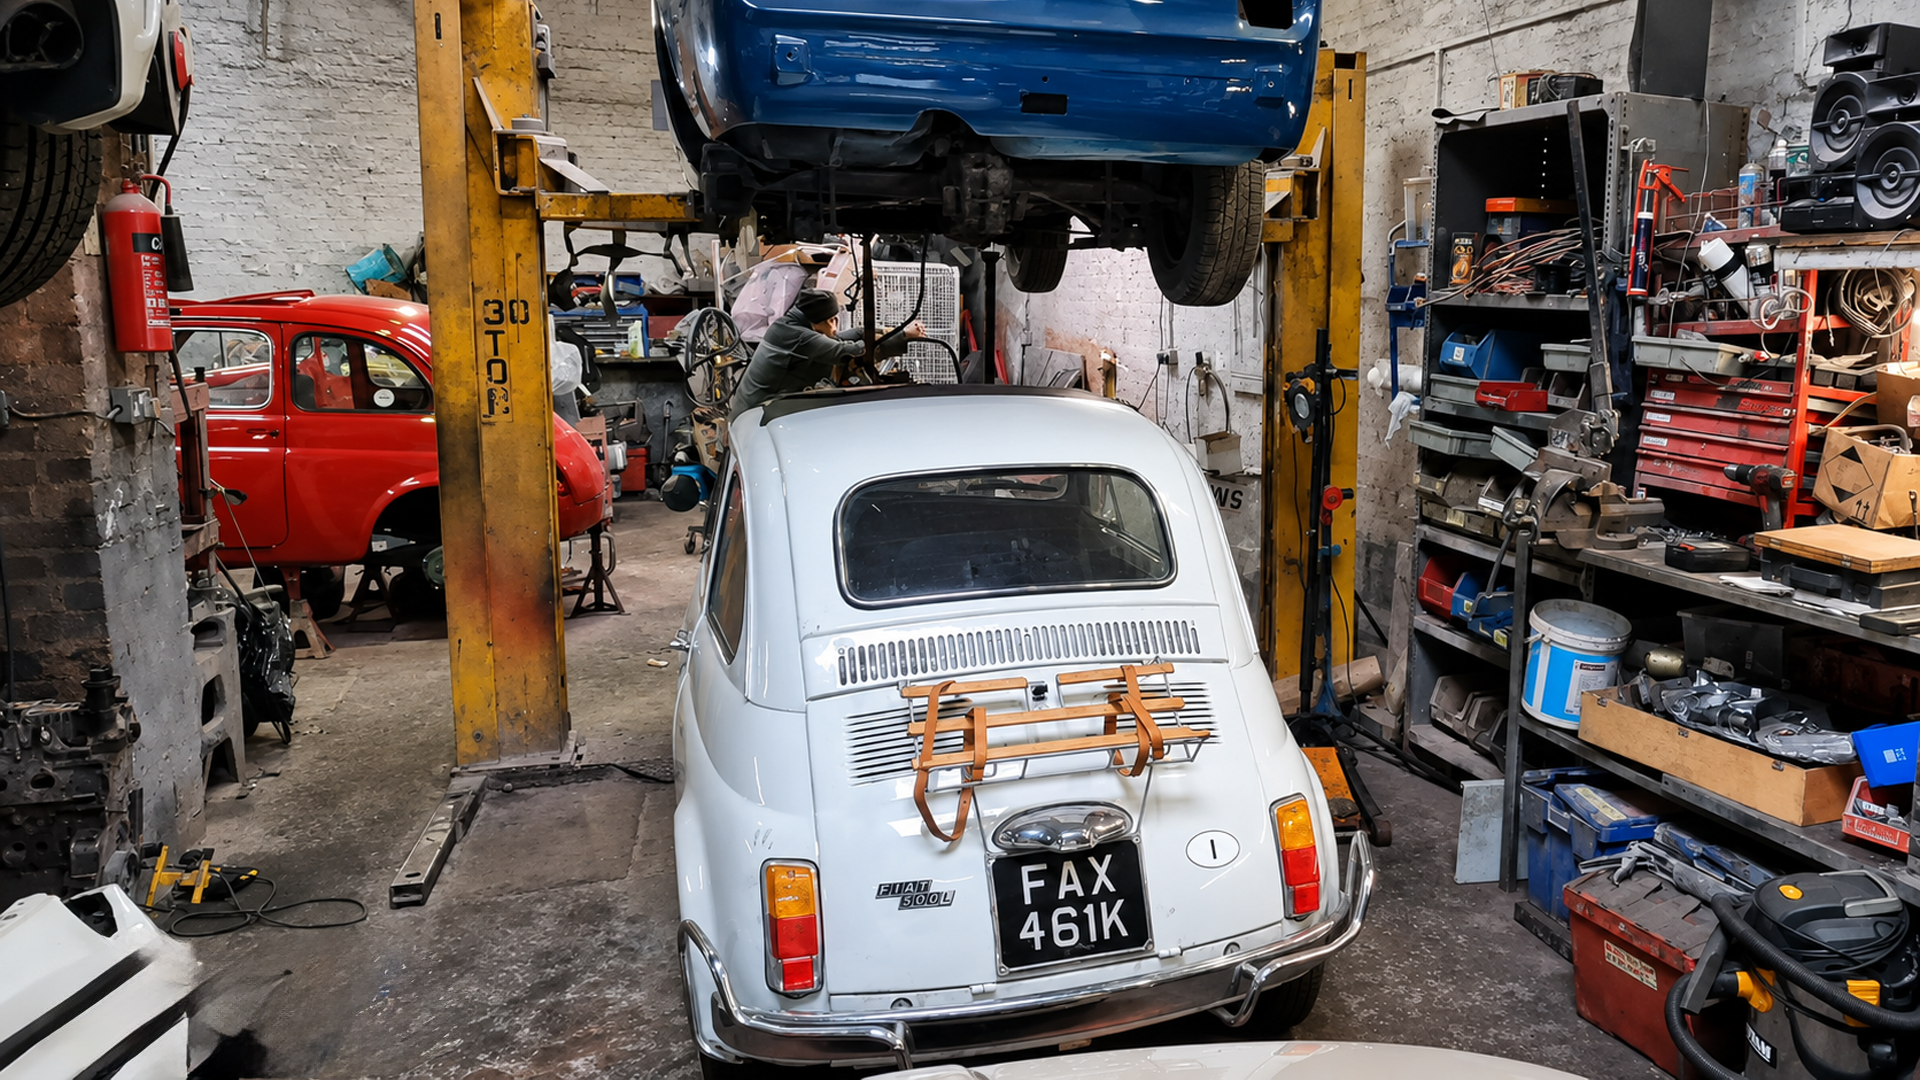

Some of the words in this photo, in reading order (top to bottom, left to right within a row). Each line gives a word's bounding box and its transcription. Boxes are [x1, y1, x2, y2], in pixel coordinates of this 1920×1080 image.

[483, 299, 530, 325] 30
[879, 881, 931, 897] FIAT
[1021, 854, 1117, 906] FAX
[902, 890, 954, 908] 500L
[1019, 899, 1130, 951] 461K
